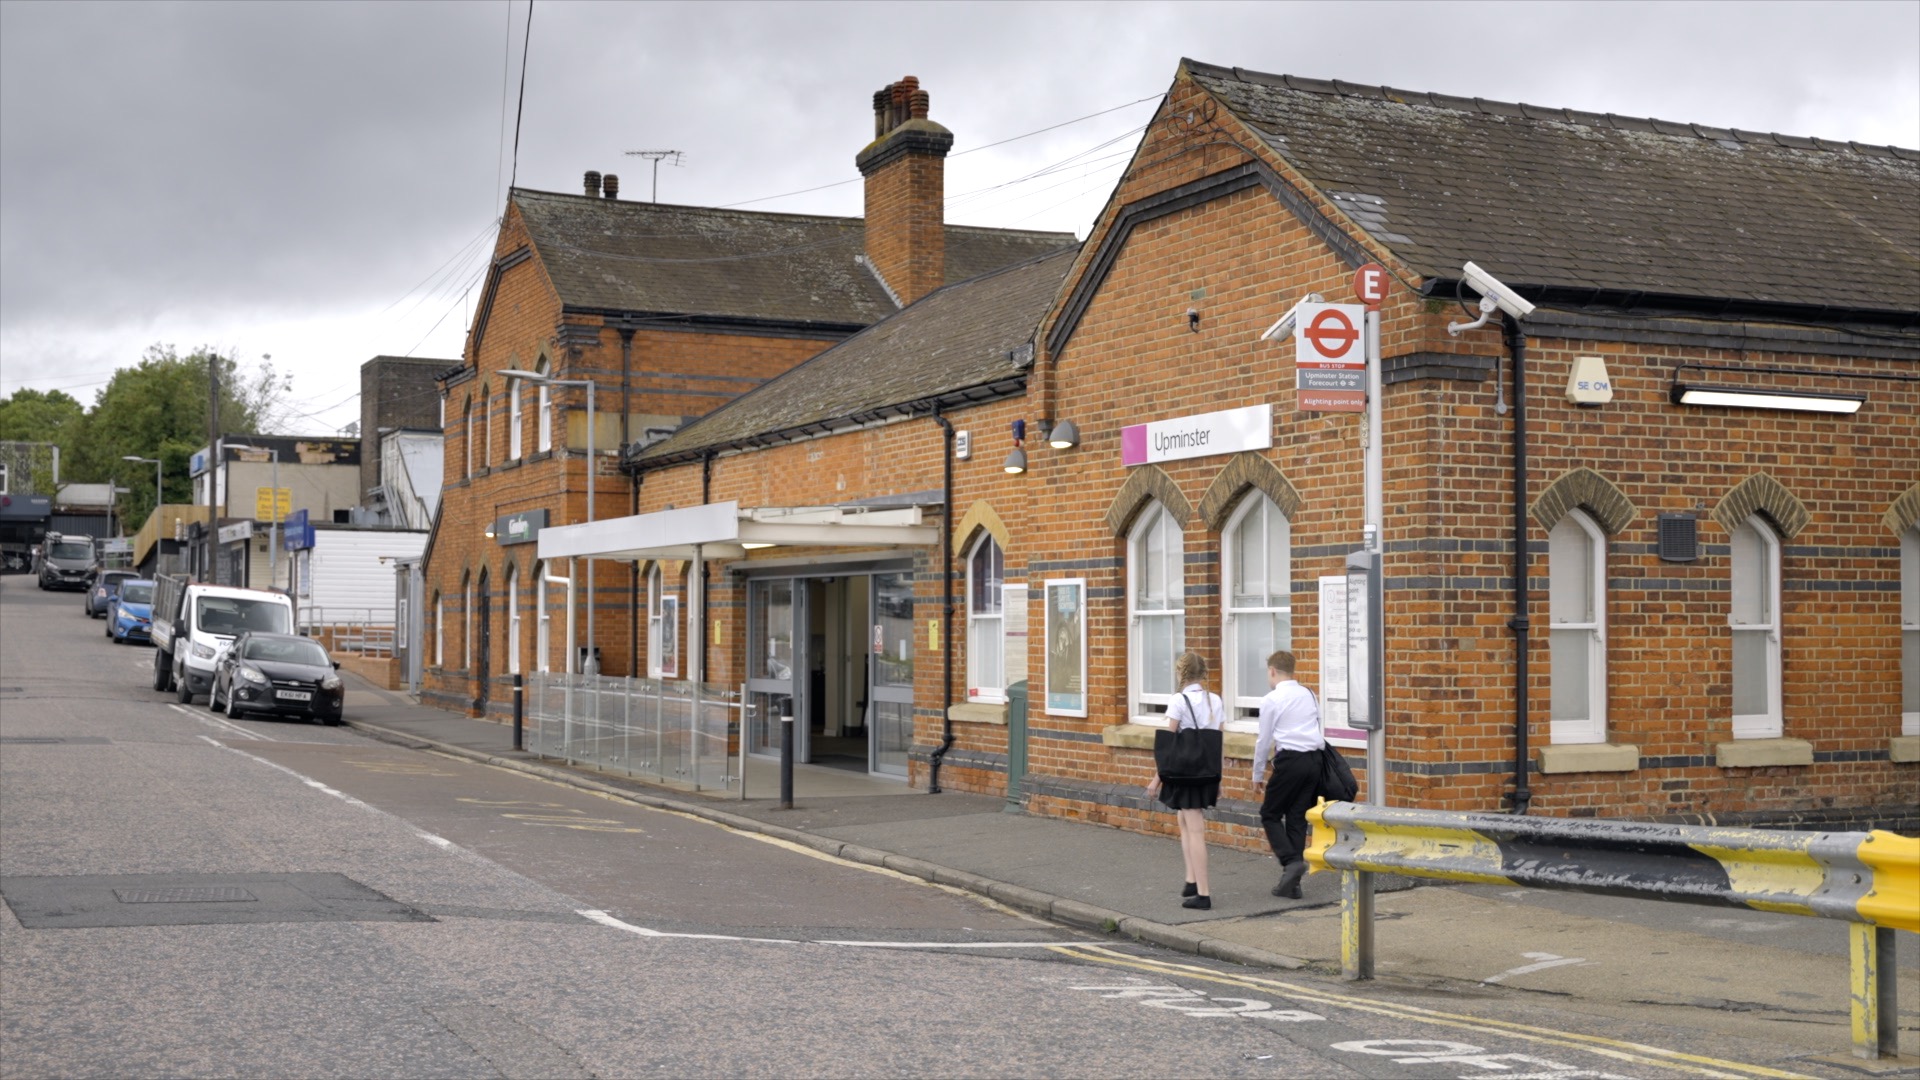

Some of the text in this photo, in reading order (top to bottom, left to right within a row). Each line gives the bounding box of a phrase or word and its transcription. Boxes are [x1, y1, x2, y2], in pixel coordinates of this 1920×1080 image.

[1364, 270, 1381, 300] E
[1305, 372, 1359, 381] Upminster Station
[1304, 398, 1332, 406] Alighting
[1350, 399, 1363, 407] only
[1154, 428, 1210, 455] Upminster
